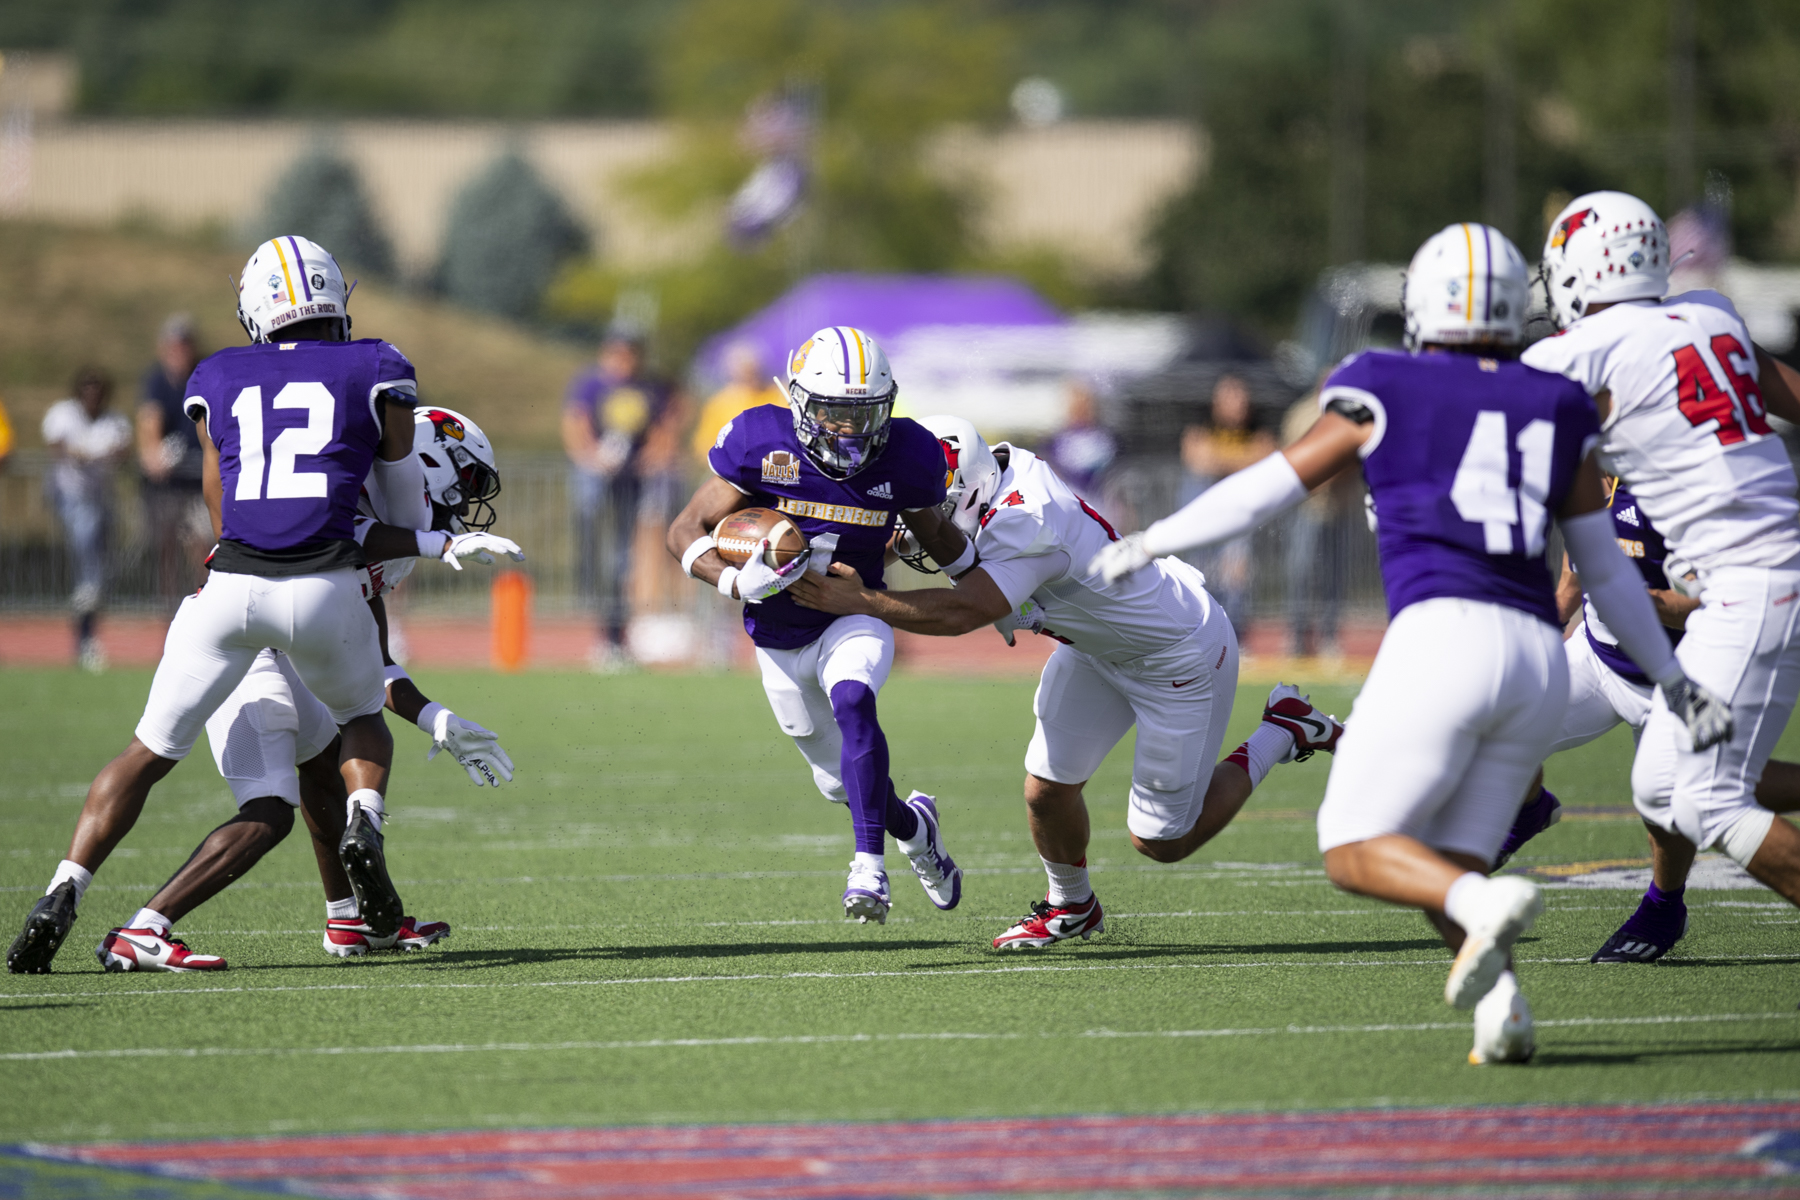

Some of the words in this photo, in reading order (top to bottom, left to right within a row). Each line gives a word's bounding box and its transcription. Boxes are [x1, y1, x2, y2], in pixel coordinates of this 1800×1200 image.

[271, 309, 298, 328] POUND
[299, 304, 316, 316] THE
[317, 304, 337, 314] ROCK
[1672, 333, 1775, 446] 46
[231, 382, 335, 501] 12
[762, 458, 800, 479] VALLEY
[866, 489, 893, 500] adidas
[1450, 410, 1556, 559] 41
[775, 496, 888, 526] LEATHERNECKS
